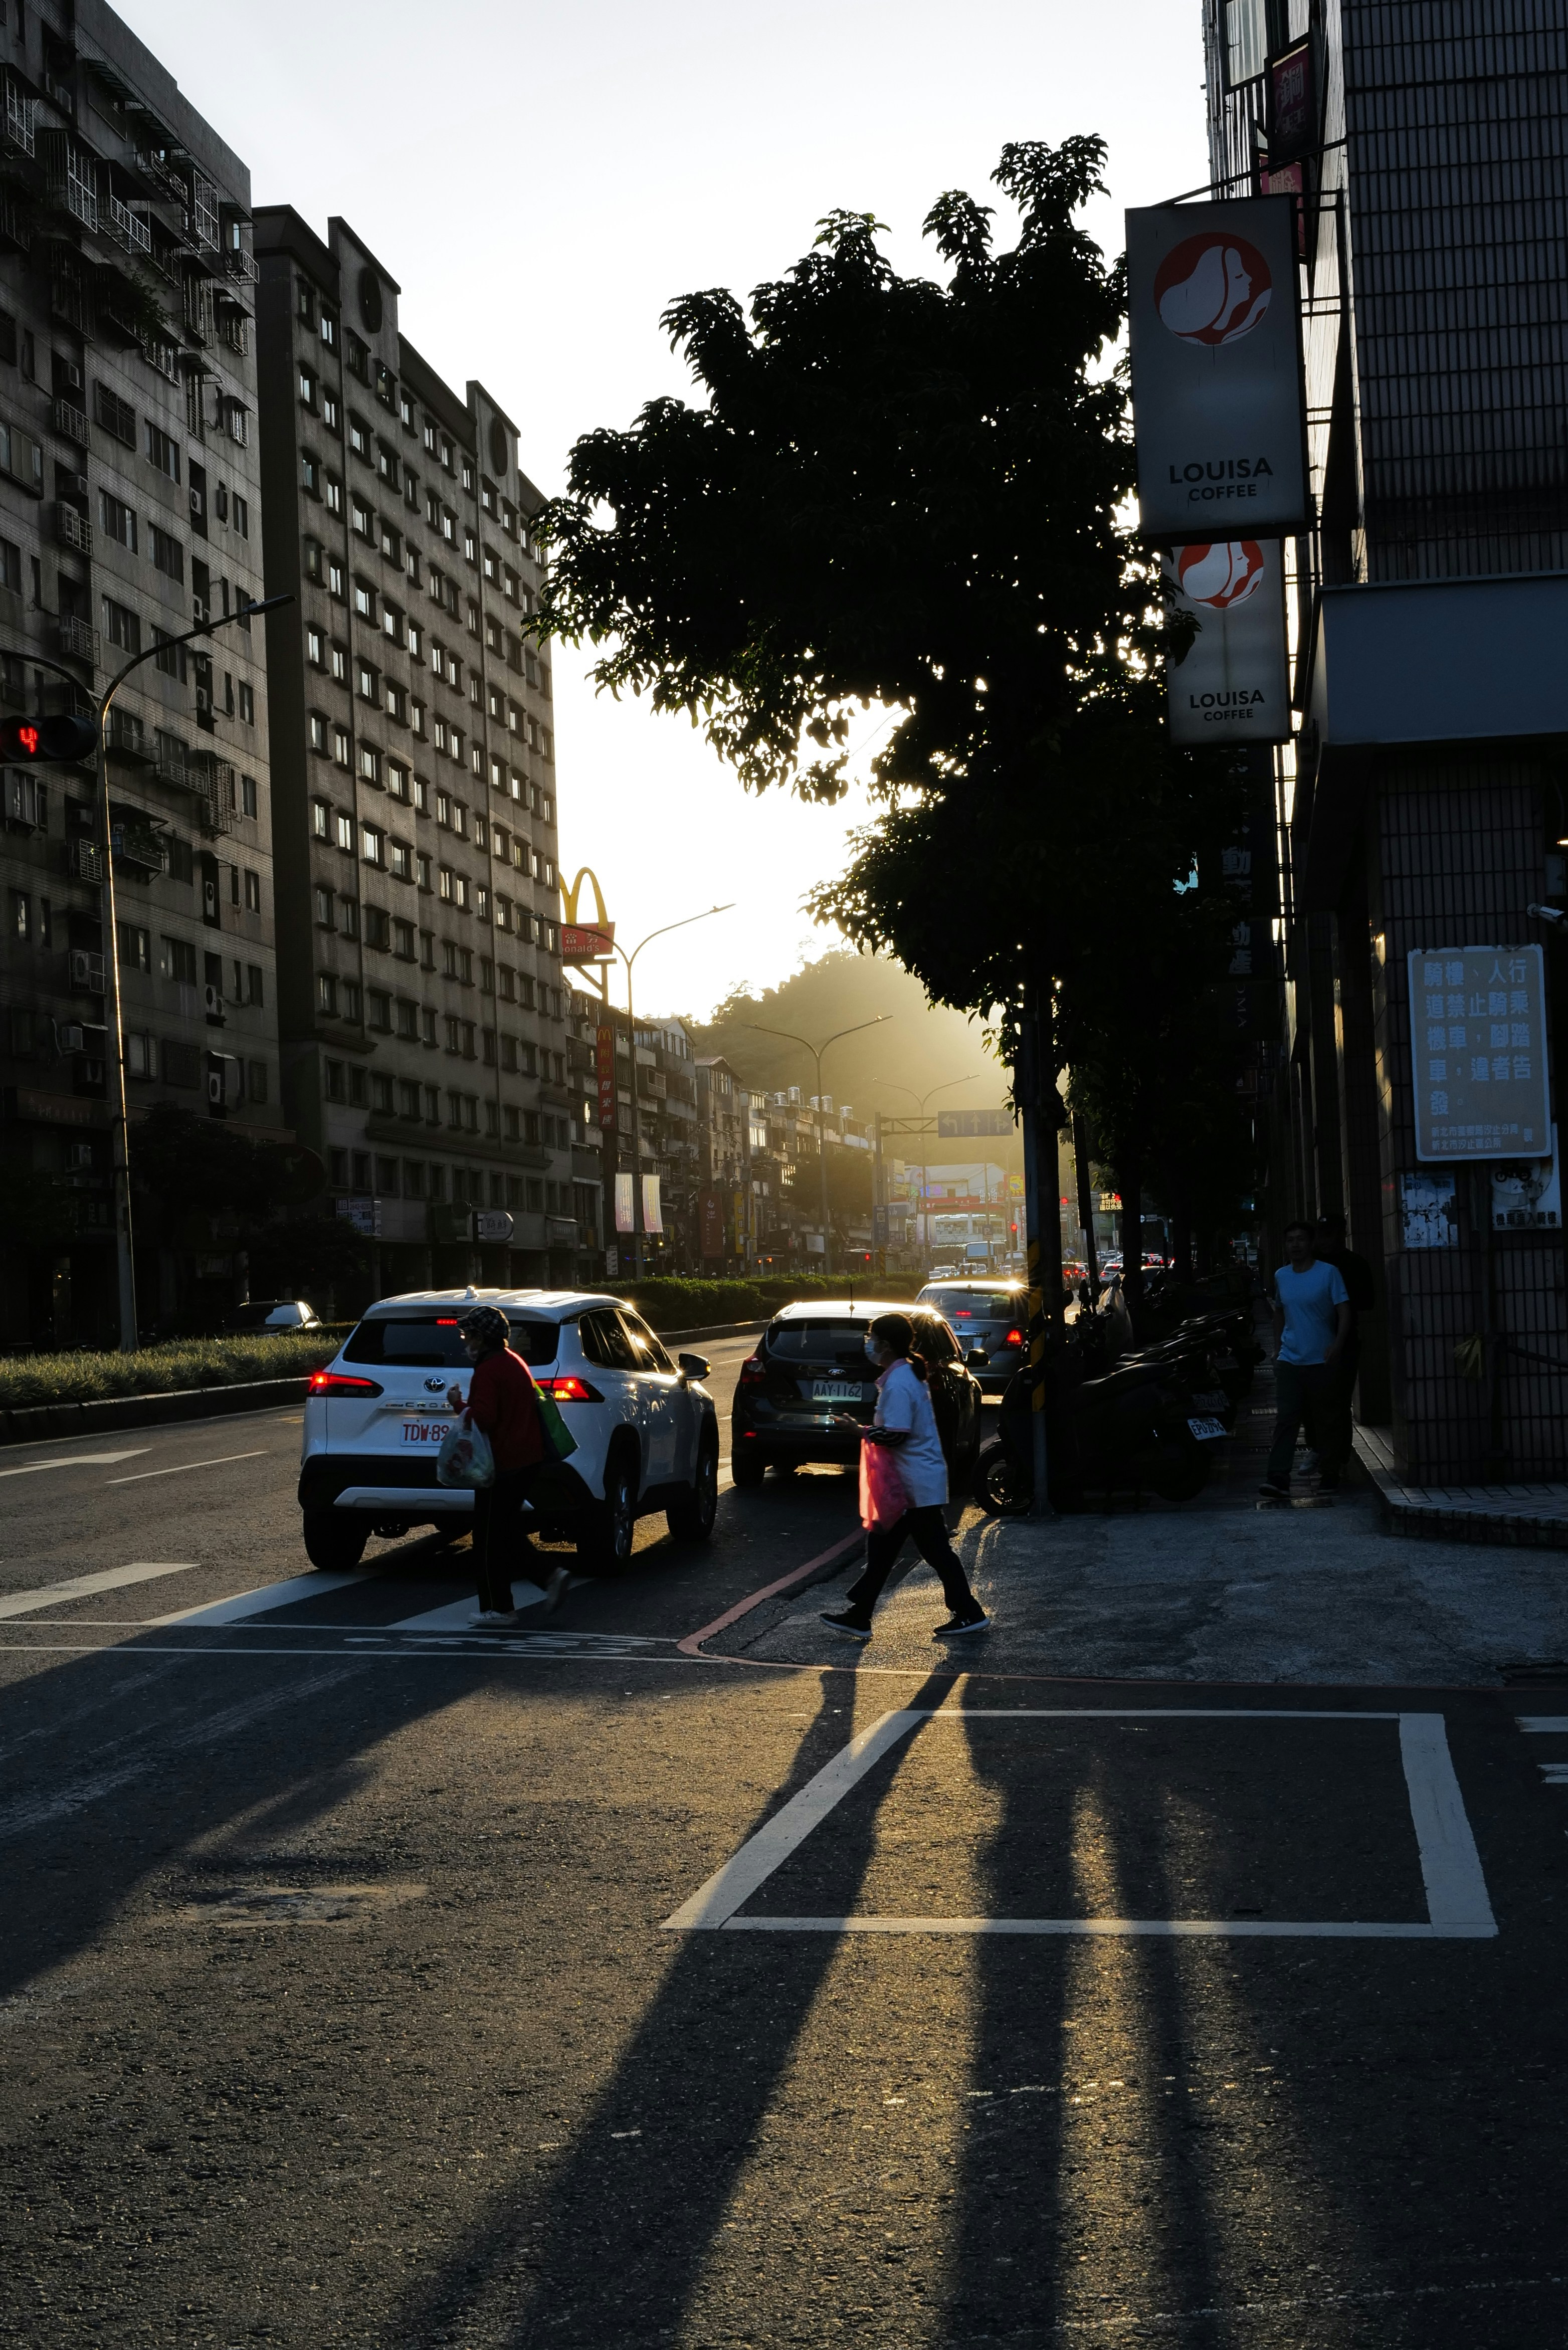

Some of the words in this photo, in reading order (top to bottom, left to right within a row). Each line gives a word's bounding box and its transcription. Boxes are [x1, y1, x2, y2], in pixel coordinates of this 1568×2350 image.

[1169, 457, 1273, 484] LOUISA
[1189, 484, 1257, 501] COFFEE
[1190, 689, 1265, 708] LOUISA
[1204, 709, 1253, 721] COFFEE
[20, 728, 36, 752] 4
[1424, 959, 1527, 987] 騎樓、人行
[1427, 990, 1528, 1018] 道禁止騎乘
[1432, 1137, 1502, 1150] 新北市汐止區公所
[1492, 1211, 1556, 1226] 機車進入騎樓
[814, 1384, 862, 1398] AAY-1162
[1191, 1422, 1225, 1436] EPU-2796
